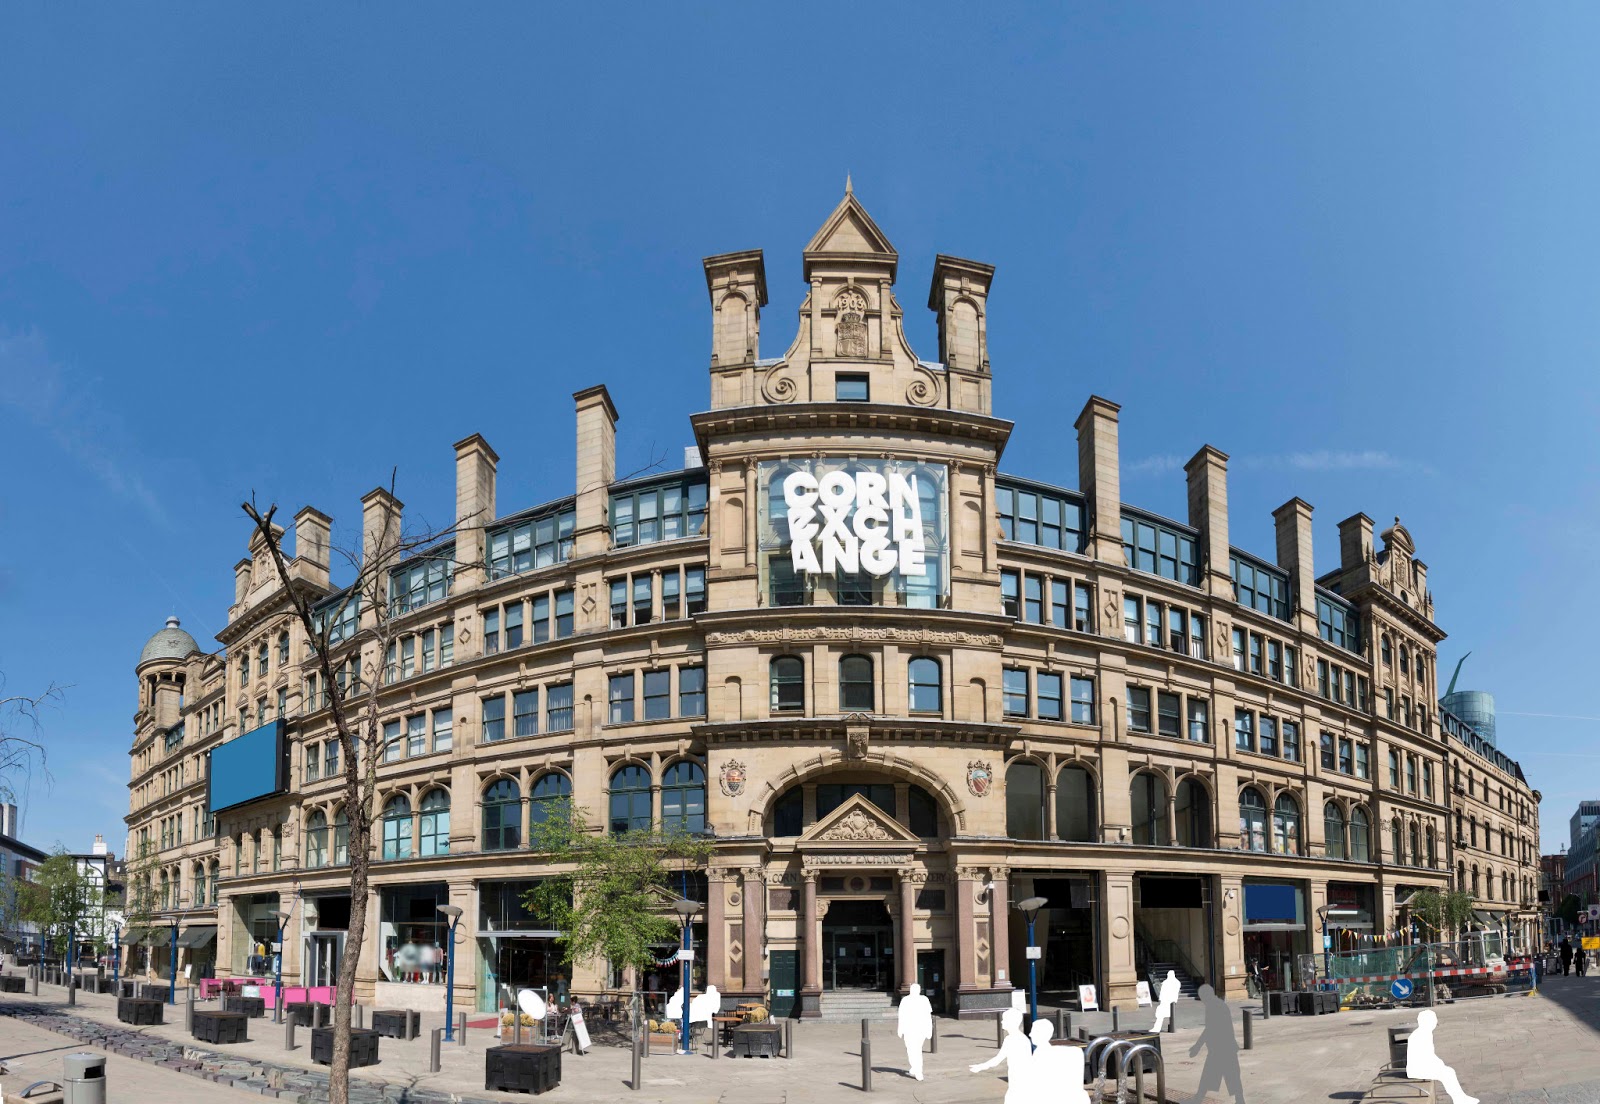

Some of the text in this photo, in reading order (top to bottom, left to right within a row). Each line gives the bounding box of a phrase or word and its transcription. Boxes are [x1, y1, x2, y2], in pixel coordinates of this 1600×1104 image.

[837, 298, 864, 310] 1903
[783, 470, 921, 510] CORN
[787, 505, 924, 543] EXCH
[790, 536, 927, 576] ANGE
[810, 854, 906, 865] PRODUCE EXCHANGE
[772, 872, 797, 884] CORN
